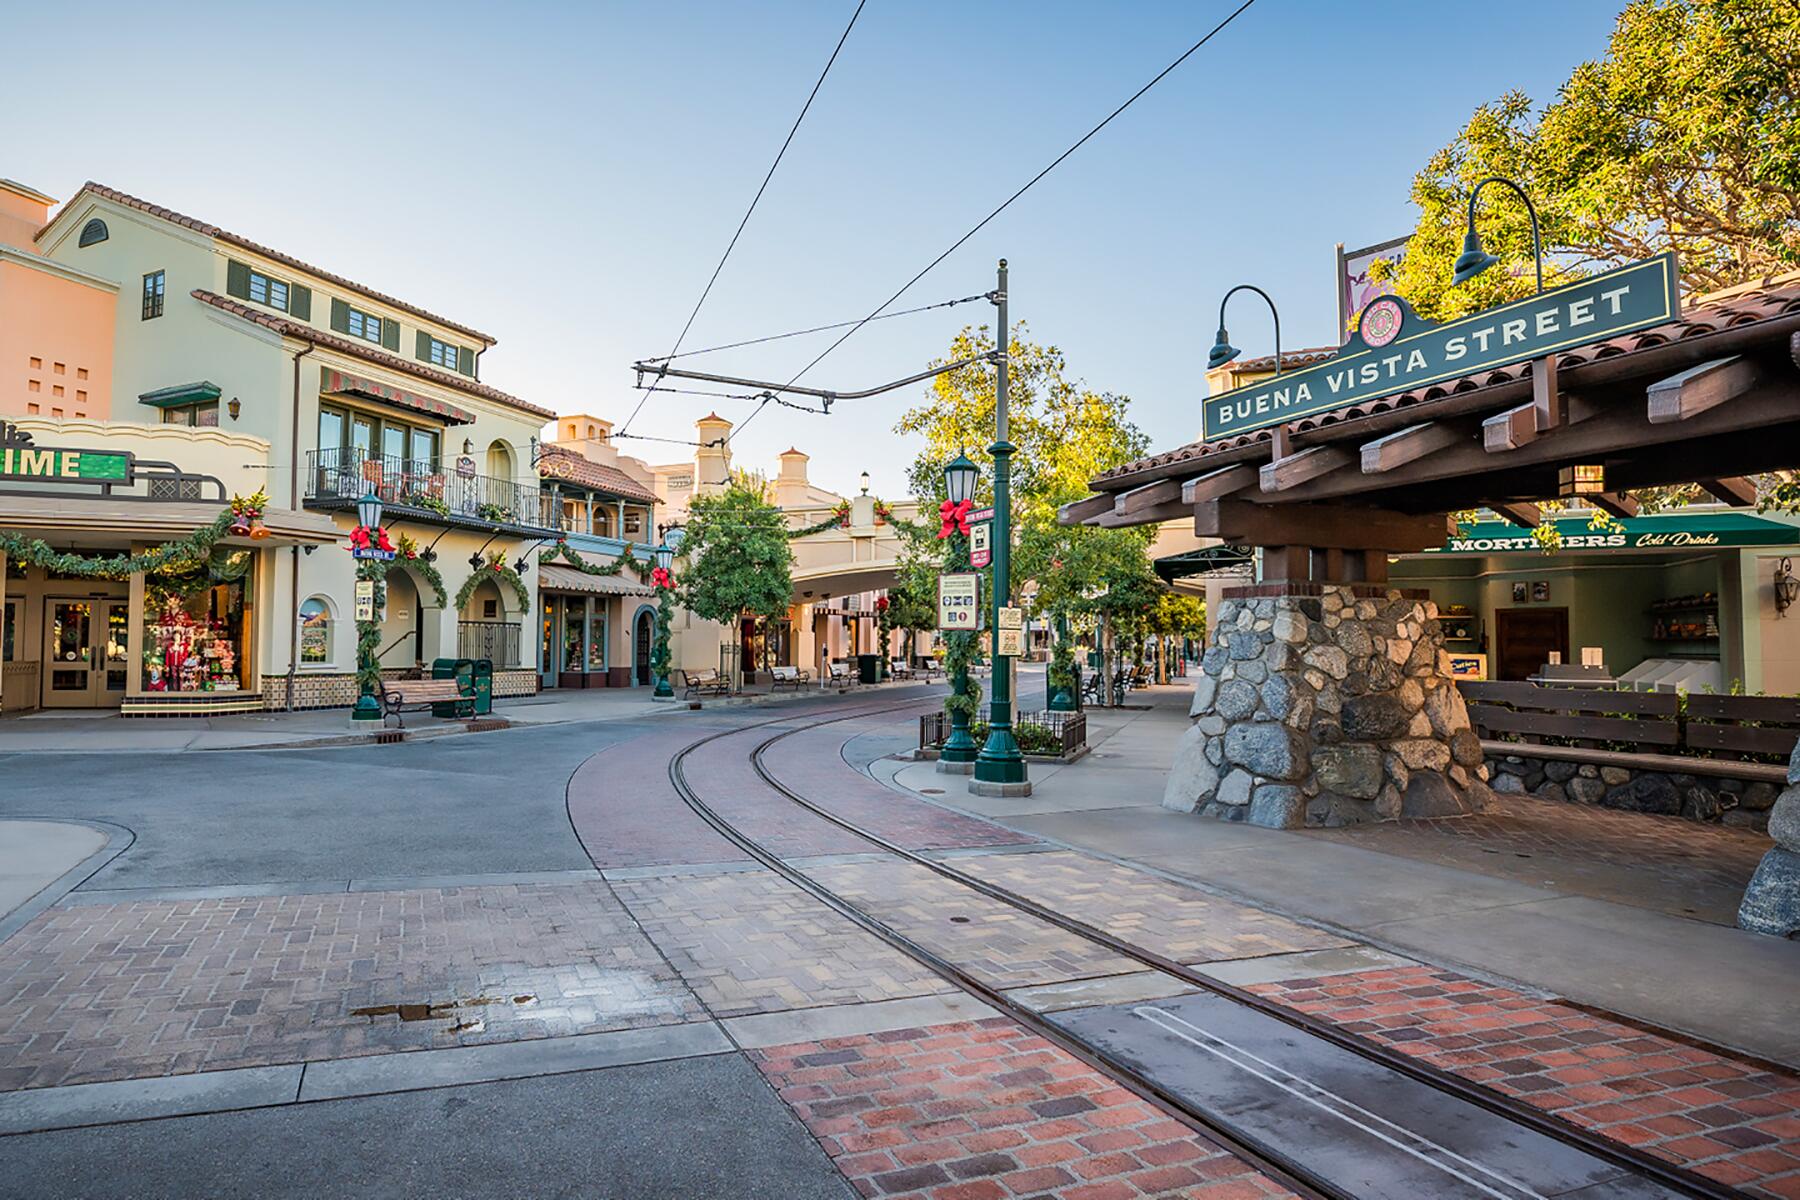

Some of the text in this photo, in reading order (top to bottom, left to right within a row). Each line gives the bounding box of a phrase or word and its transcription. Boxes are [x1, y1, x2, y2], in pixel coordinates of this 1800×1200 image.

[1219, 383, 1312, 425] BUENA
[1326, 349, 1428, 394] VISTA
[1445, 285, 1630, 361] STREET
[1635, 533, 1670, 547] Cold
[1668, 532, 1720, 546] Drinks
